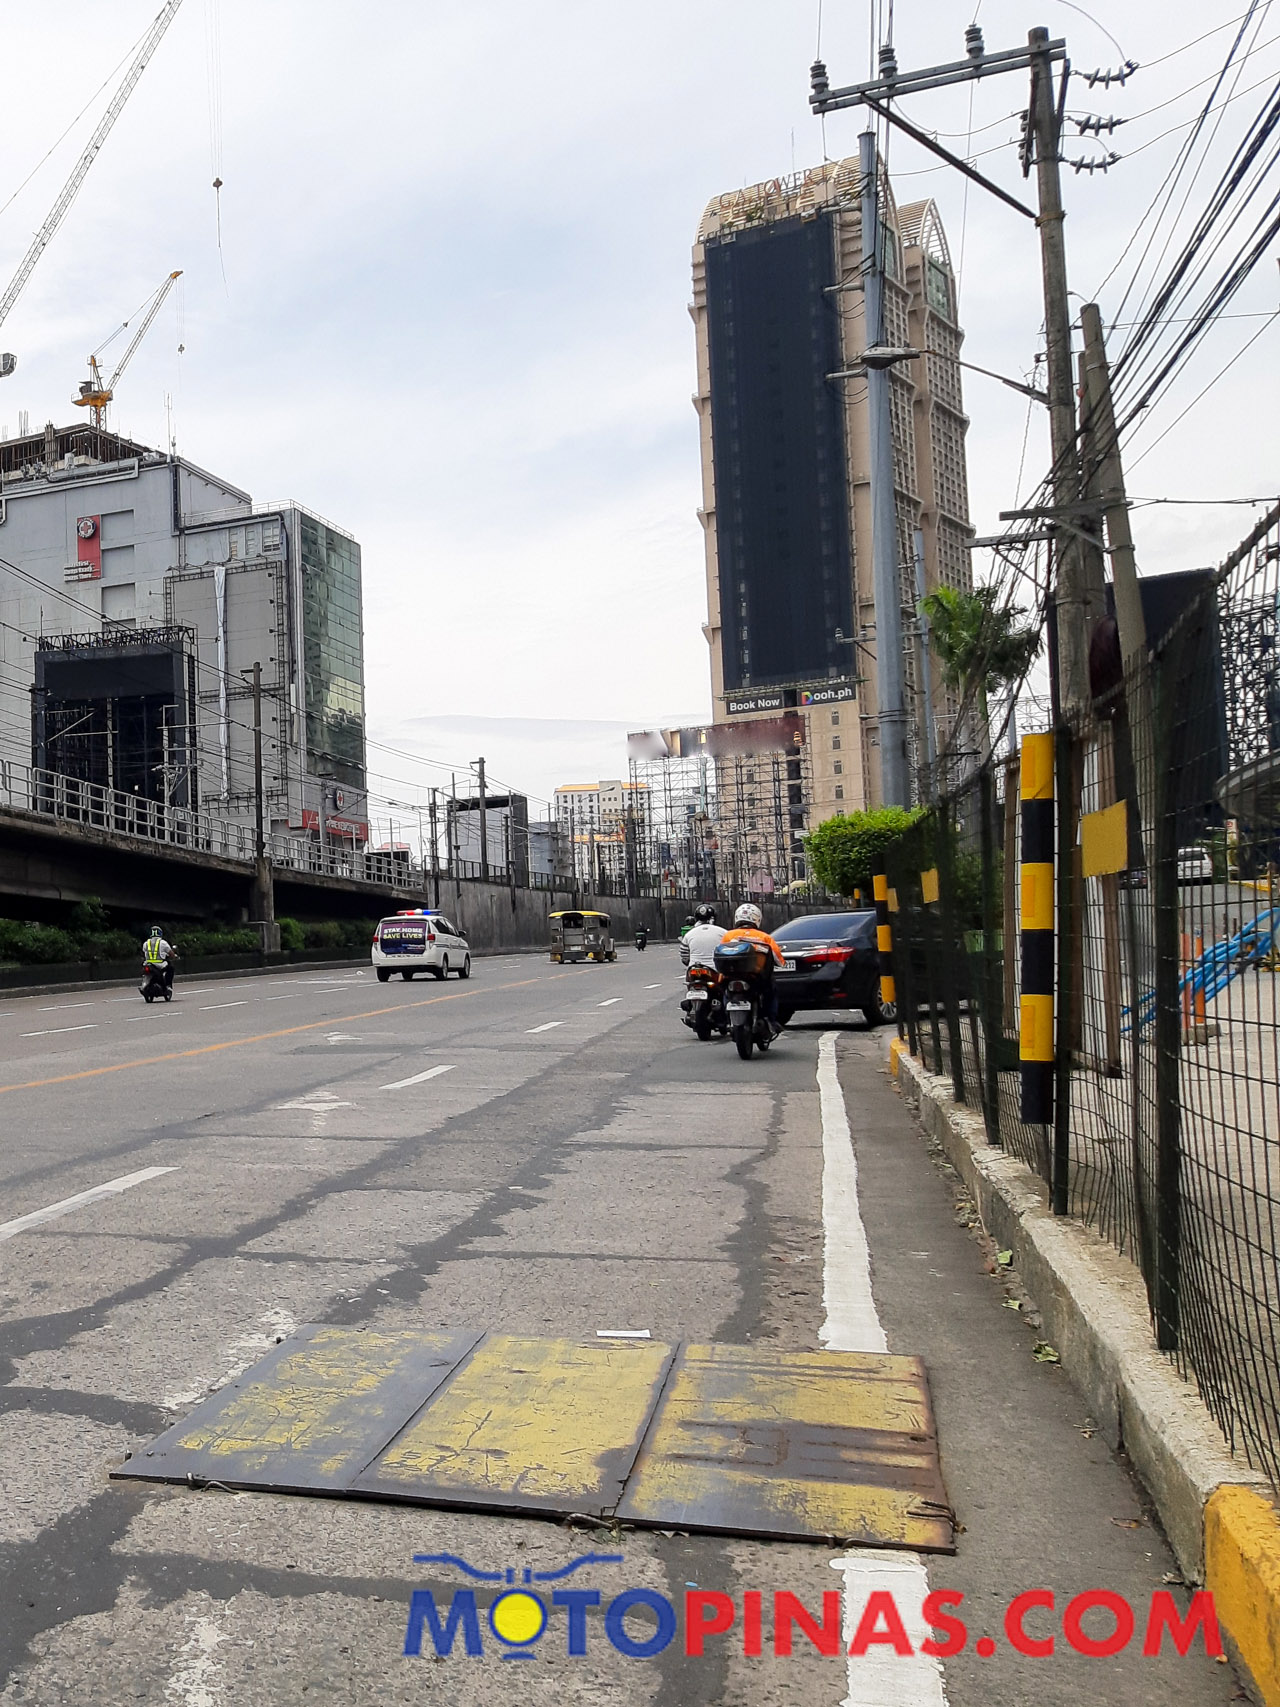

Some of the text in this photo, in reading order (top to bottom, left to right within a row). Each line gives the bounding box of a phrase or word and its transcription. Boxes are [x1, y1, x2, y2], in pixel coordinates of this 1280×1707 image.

[755, 168, 815, 199] TOWER
[729, 698, 780, 712] Book Now
[801, 687, 853, 705] Dooh.ph
